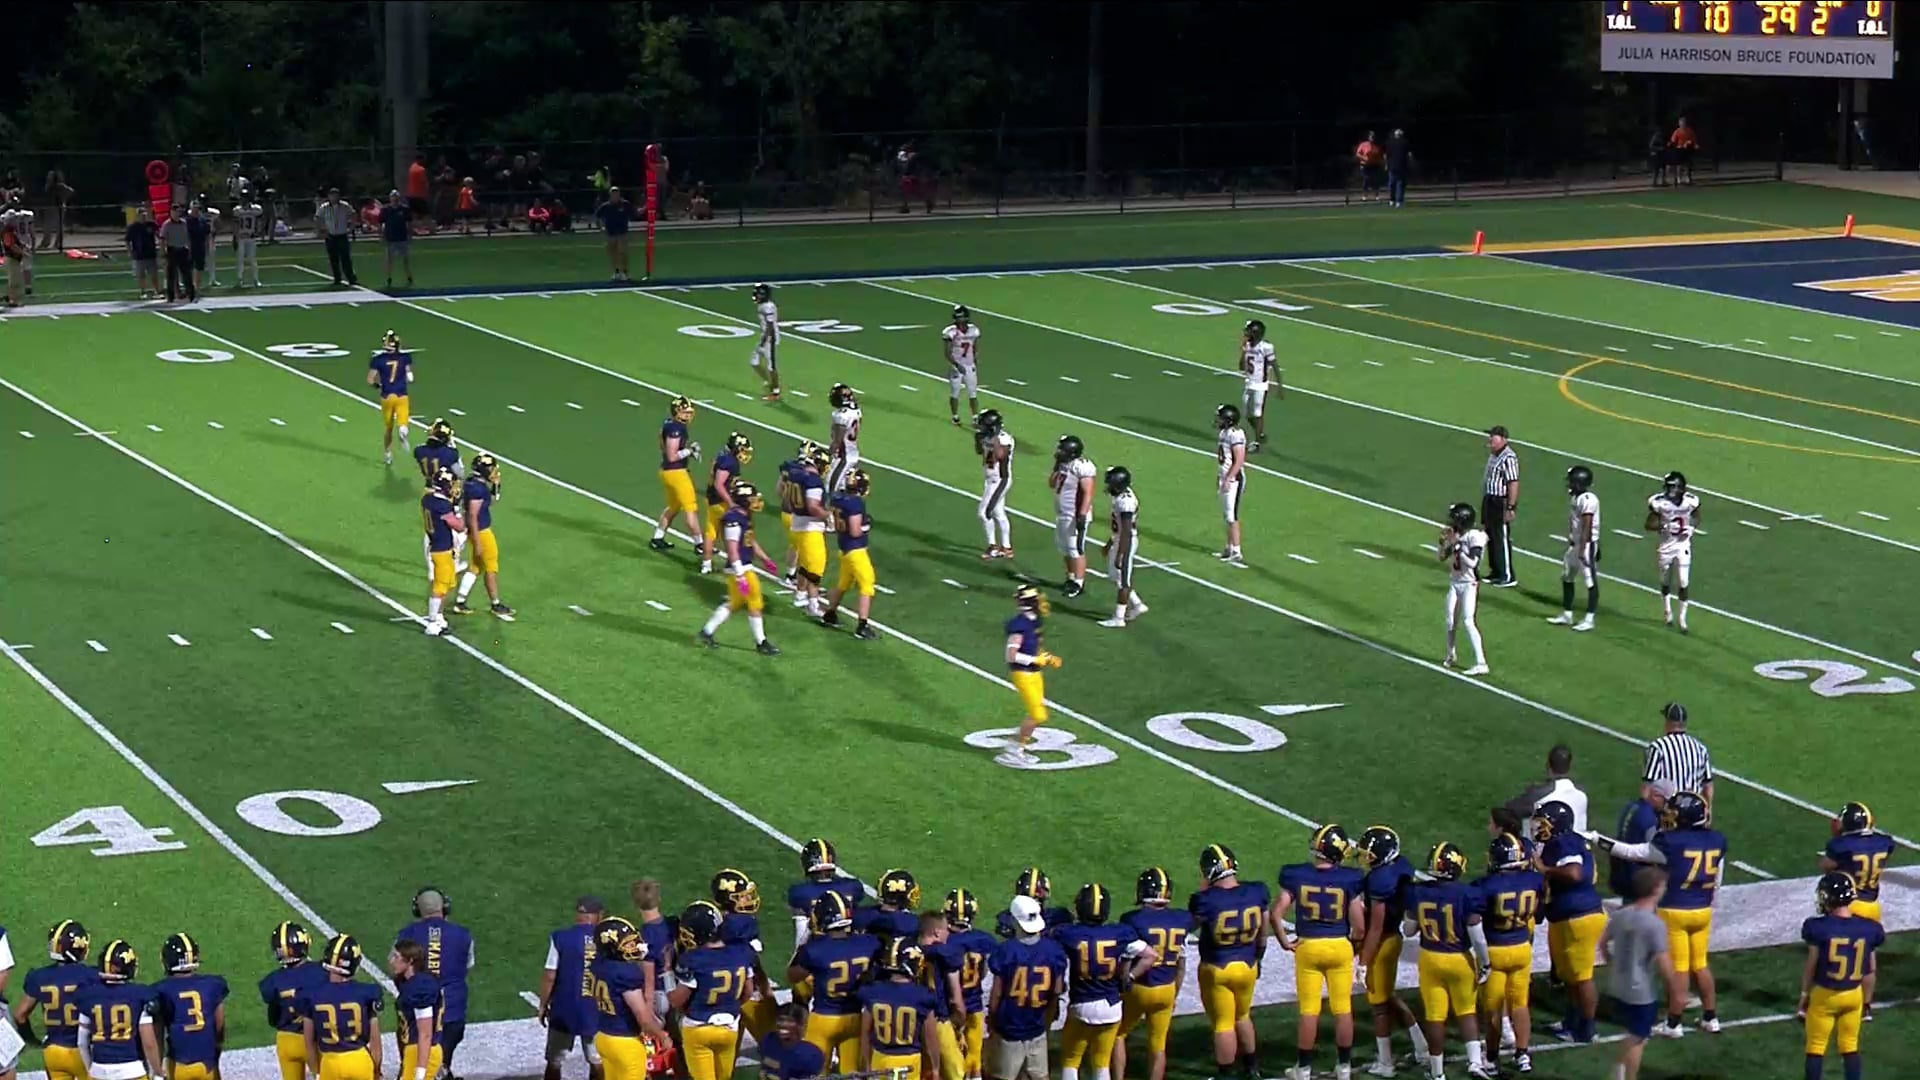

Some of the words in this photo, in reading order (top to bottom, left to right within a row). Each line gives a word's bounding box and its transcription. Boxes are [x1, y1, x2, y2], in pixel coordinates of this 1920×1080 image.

[1674, 6, 1682, 30] 1
[1705, 5, 1729, 33] 10
[1761, 6, 1796, 34] 29
[1811, 7, 1828, 35] 2
[1617, 48, 1653, 60] JULIA
[1660, 48, 1732, 62] HARRISON
[1737, 50, 1782, 63] BRUCE
[1788, 51, 1876, 65] FOUNDATION
[386, 360, 399, 383] 7
[1681, 849, 1721, 890] 75
[1300, 885, 1344, 922] 53
[1418, 902, 1460, 946] 61
[1213, 906, 1263, 947] 60
[1076, 939, 1117, 981] 15
[1826, 937, 1867, 981] 51
[1010, 965, 1052, 1008] 42
[91, 1003, 132, 1042] 18
[178, 990, 206, 1032] 3
[314, 1001, 364, 1044] 33
[872, 1002, 917, 1046] 80
